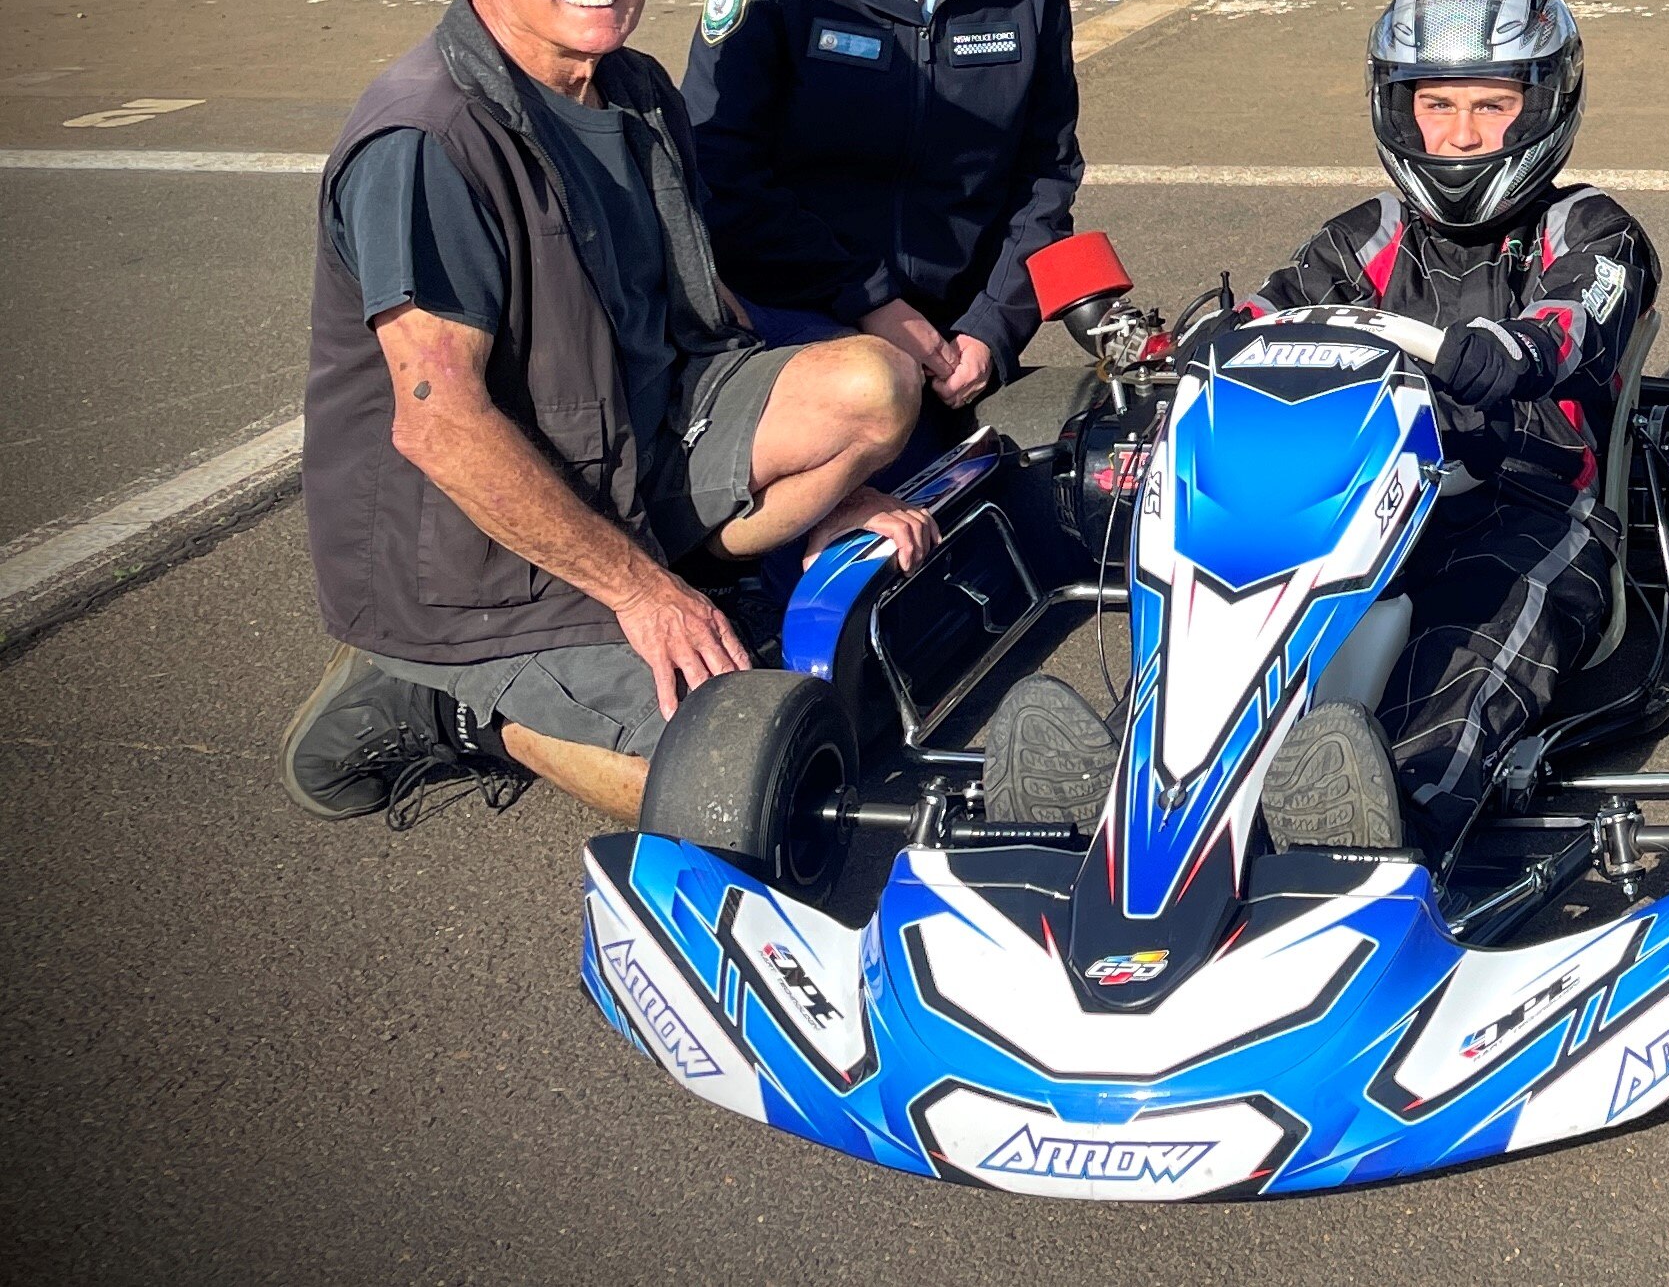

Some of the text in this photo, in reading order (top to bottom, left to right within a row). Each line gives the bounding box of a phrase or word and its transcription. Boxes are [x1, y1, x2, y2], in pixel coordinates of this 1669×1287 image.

[971, 33, 992, 42] POLICE
[992, 31, 1015, 41] FORCE
[1222, 335, 1389, 372] ARROW
[1375, 467, 1404, 540] XS
[1085, 958, 1169, 985] GPD
[602, 939, 725, 1079] ARROW
[976, 1122, 1221, 1184] ARROW
